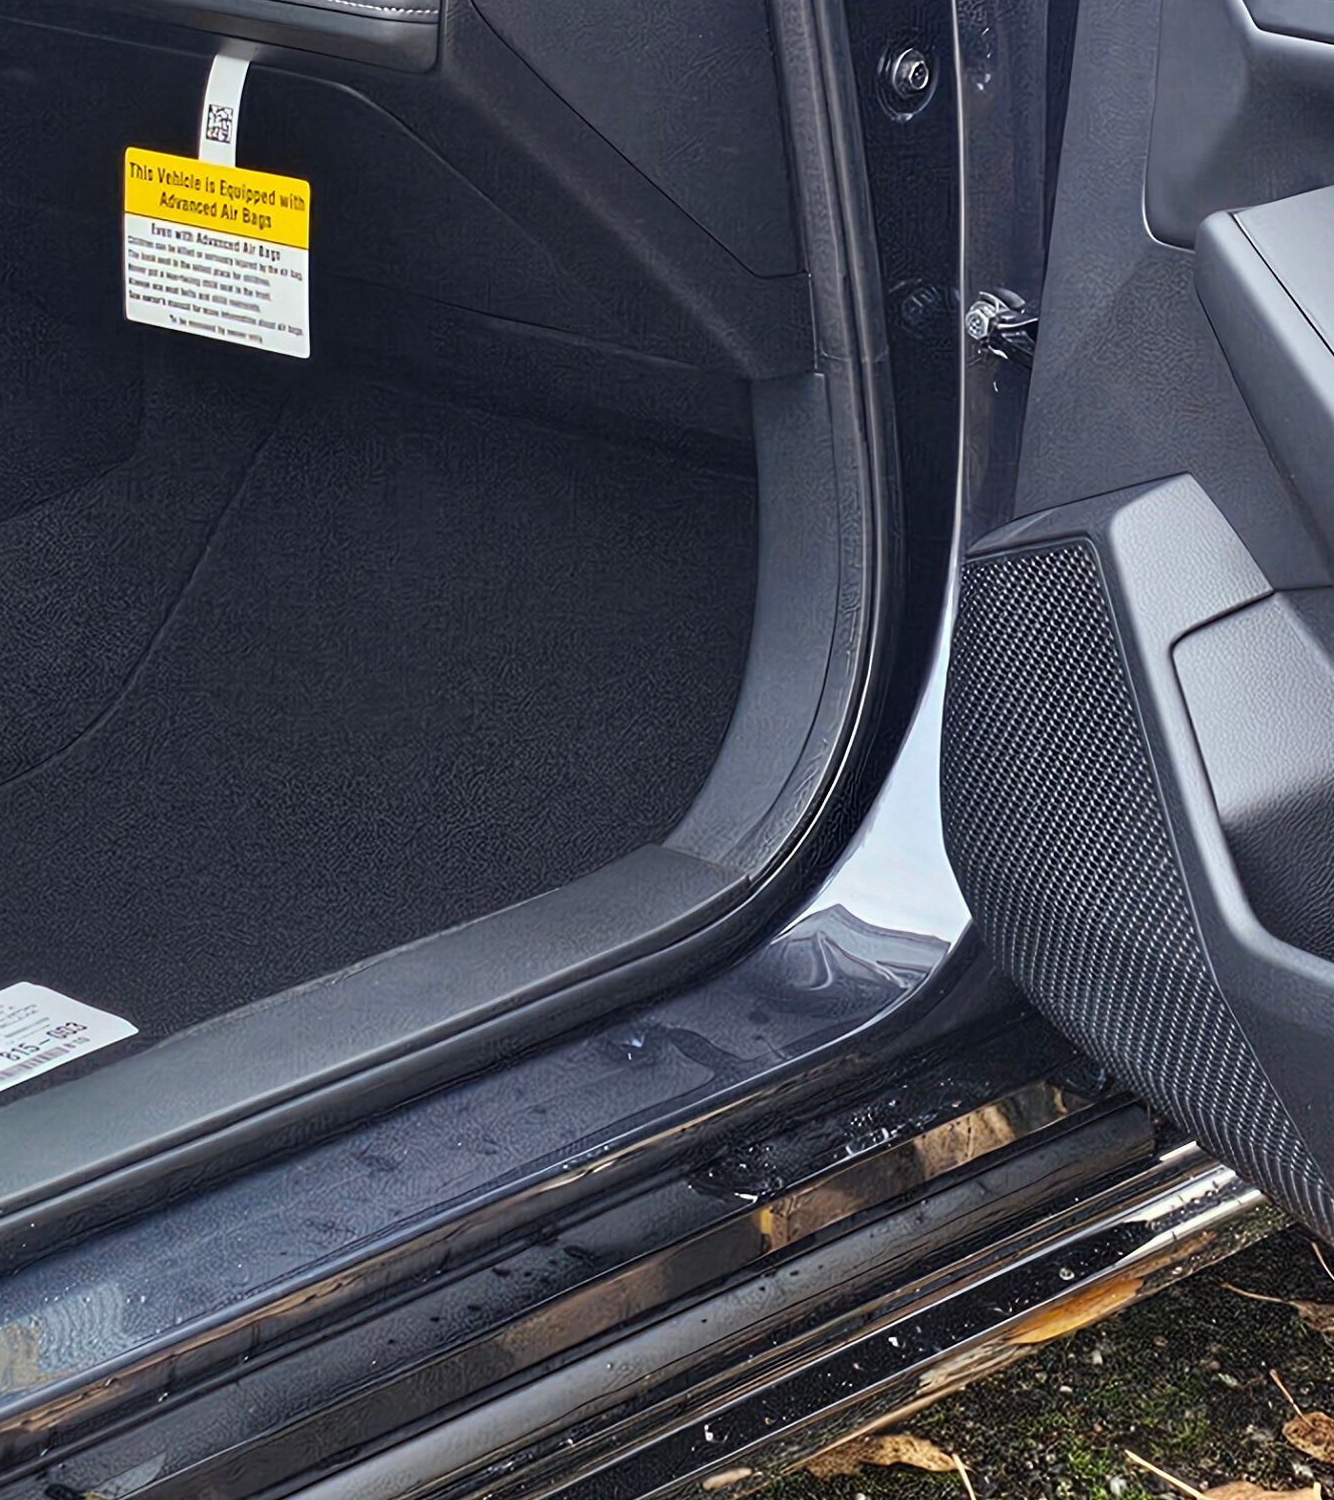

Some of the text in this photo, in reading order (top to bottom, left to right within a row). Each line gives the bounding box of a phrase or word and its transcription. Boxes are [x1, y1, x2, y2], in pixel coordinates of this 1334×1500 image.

[129, 162, 305, 212] This Vehicle is Equipped with
[159, 192, 272, 230] Advanced Air Bags
[151, 222, 280, 262] Even with Advanced Air Bags
